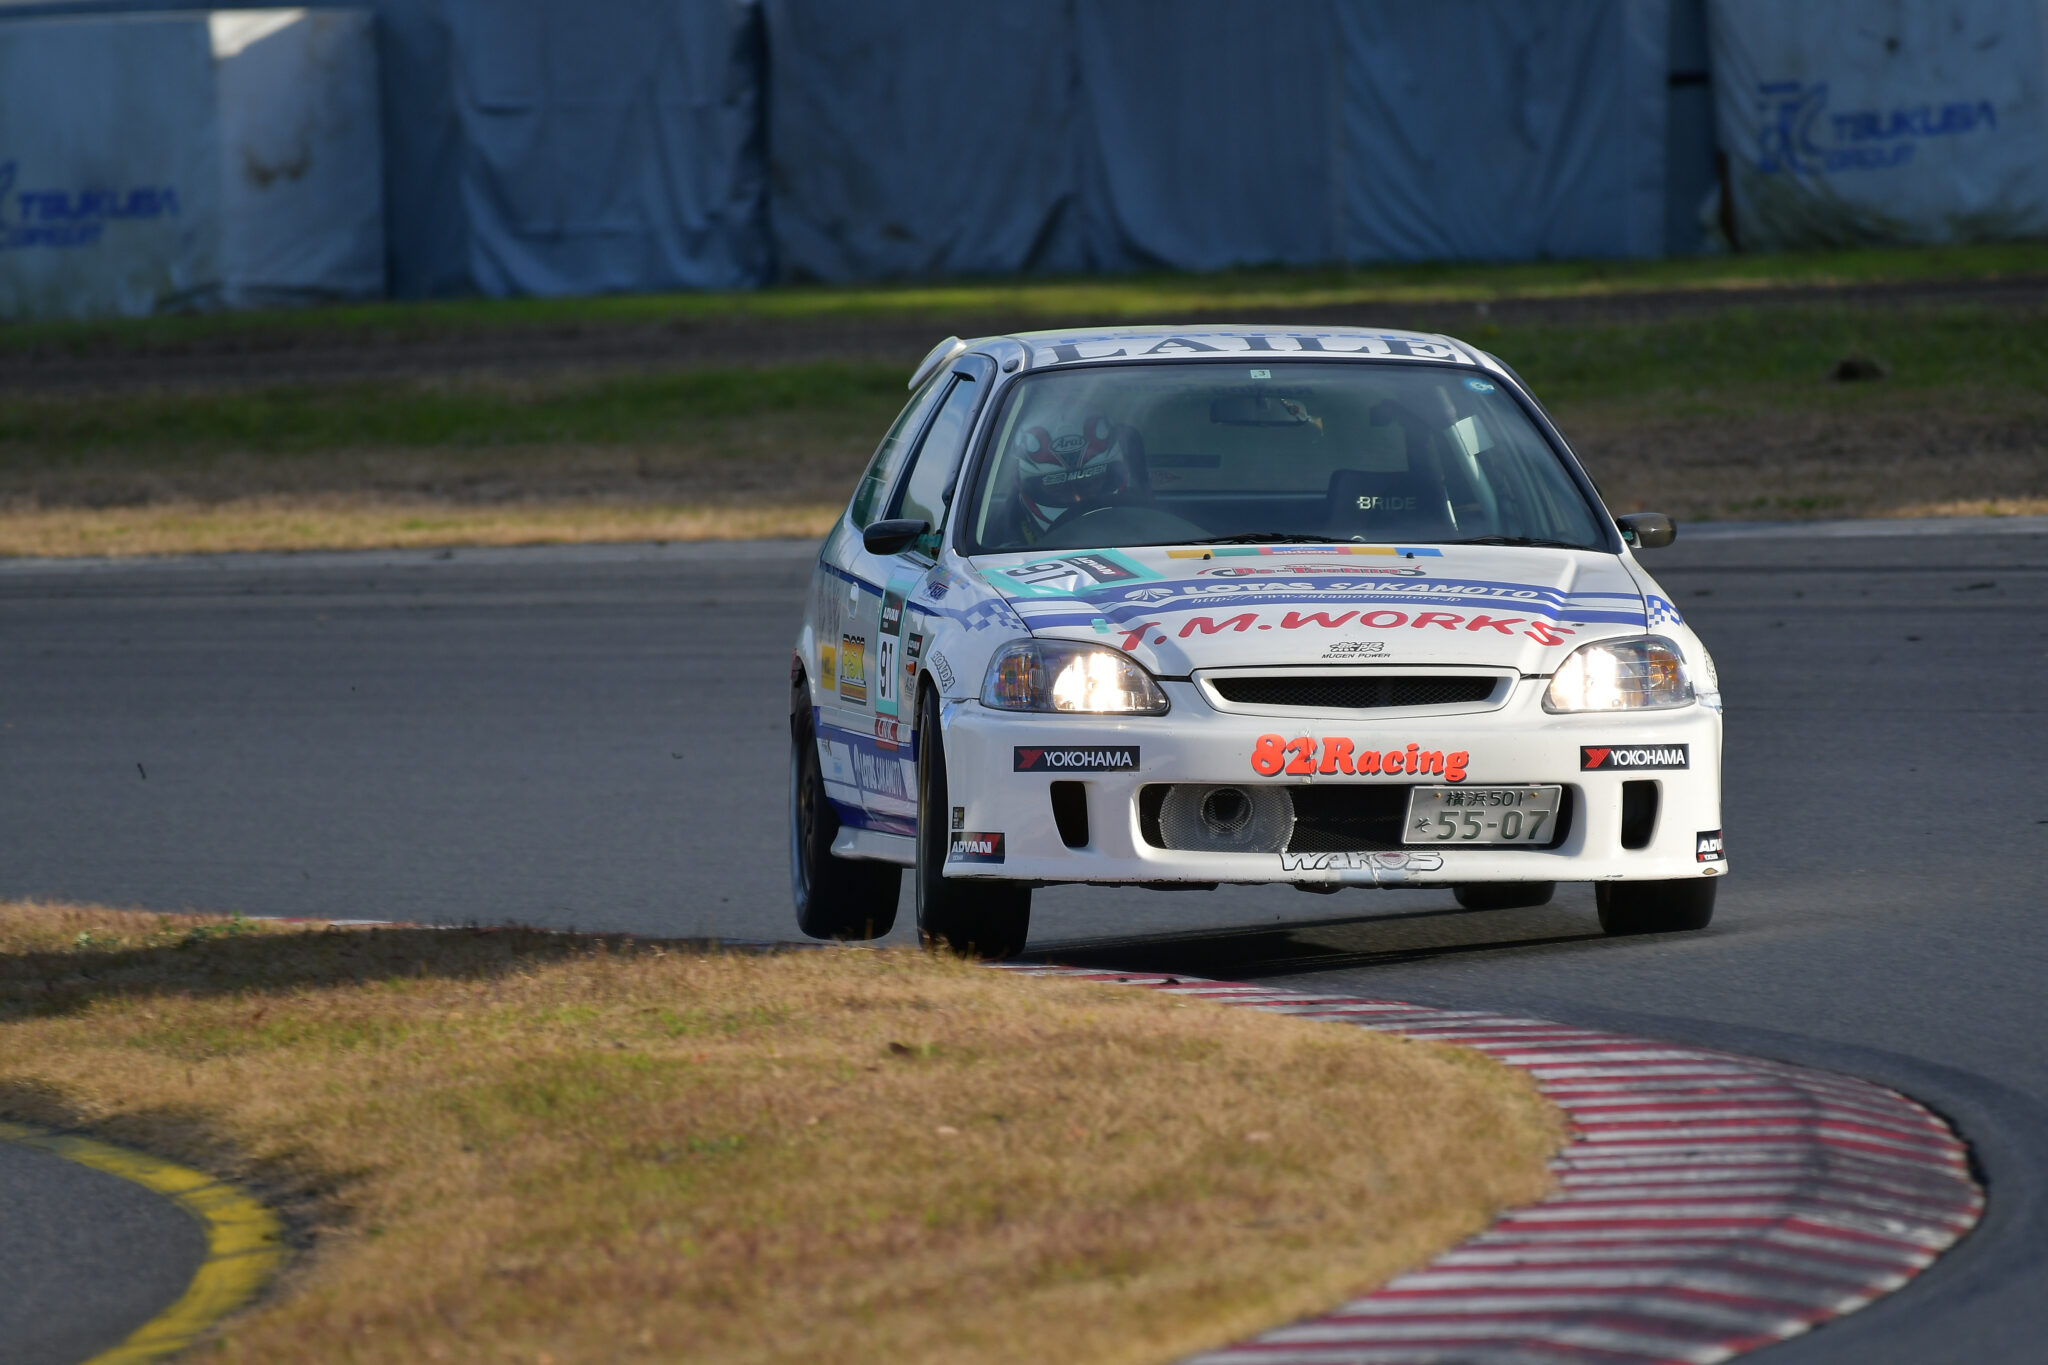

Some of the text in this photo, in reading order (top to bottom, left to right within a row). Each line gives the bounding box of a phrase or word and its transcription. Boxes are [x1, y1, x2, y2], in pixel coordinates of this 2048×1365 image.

[1832, 101, 1997, 141] TSUKUBA
[1047, 336, 1458, 365] LAILE
[1357, 496, 1417, 511] BRIDE
[1006, 563, 1078, 585] 91
[1183, 582, 1539, 599] LOTAS SAKAMOTO
[880, 641, 893, 699] 91
[1044, 751, 1133, 767] YOKOHAMA
[1610, 749, 1686, 766] YOKOHAMA
[1436, 810, 1551, 840] 55-07
[951, 841, 992, 854] ADVAN
